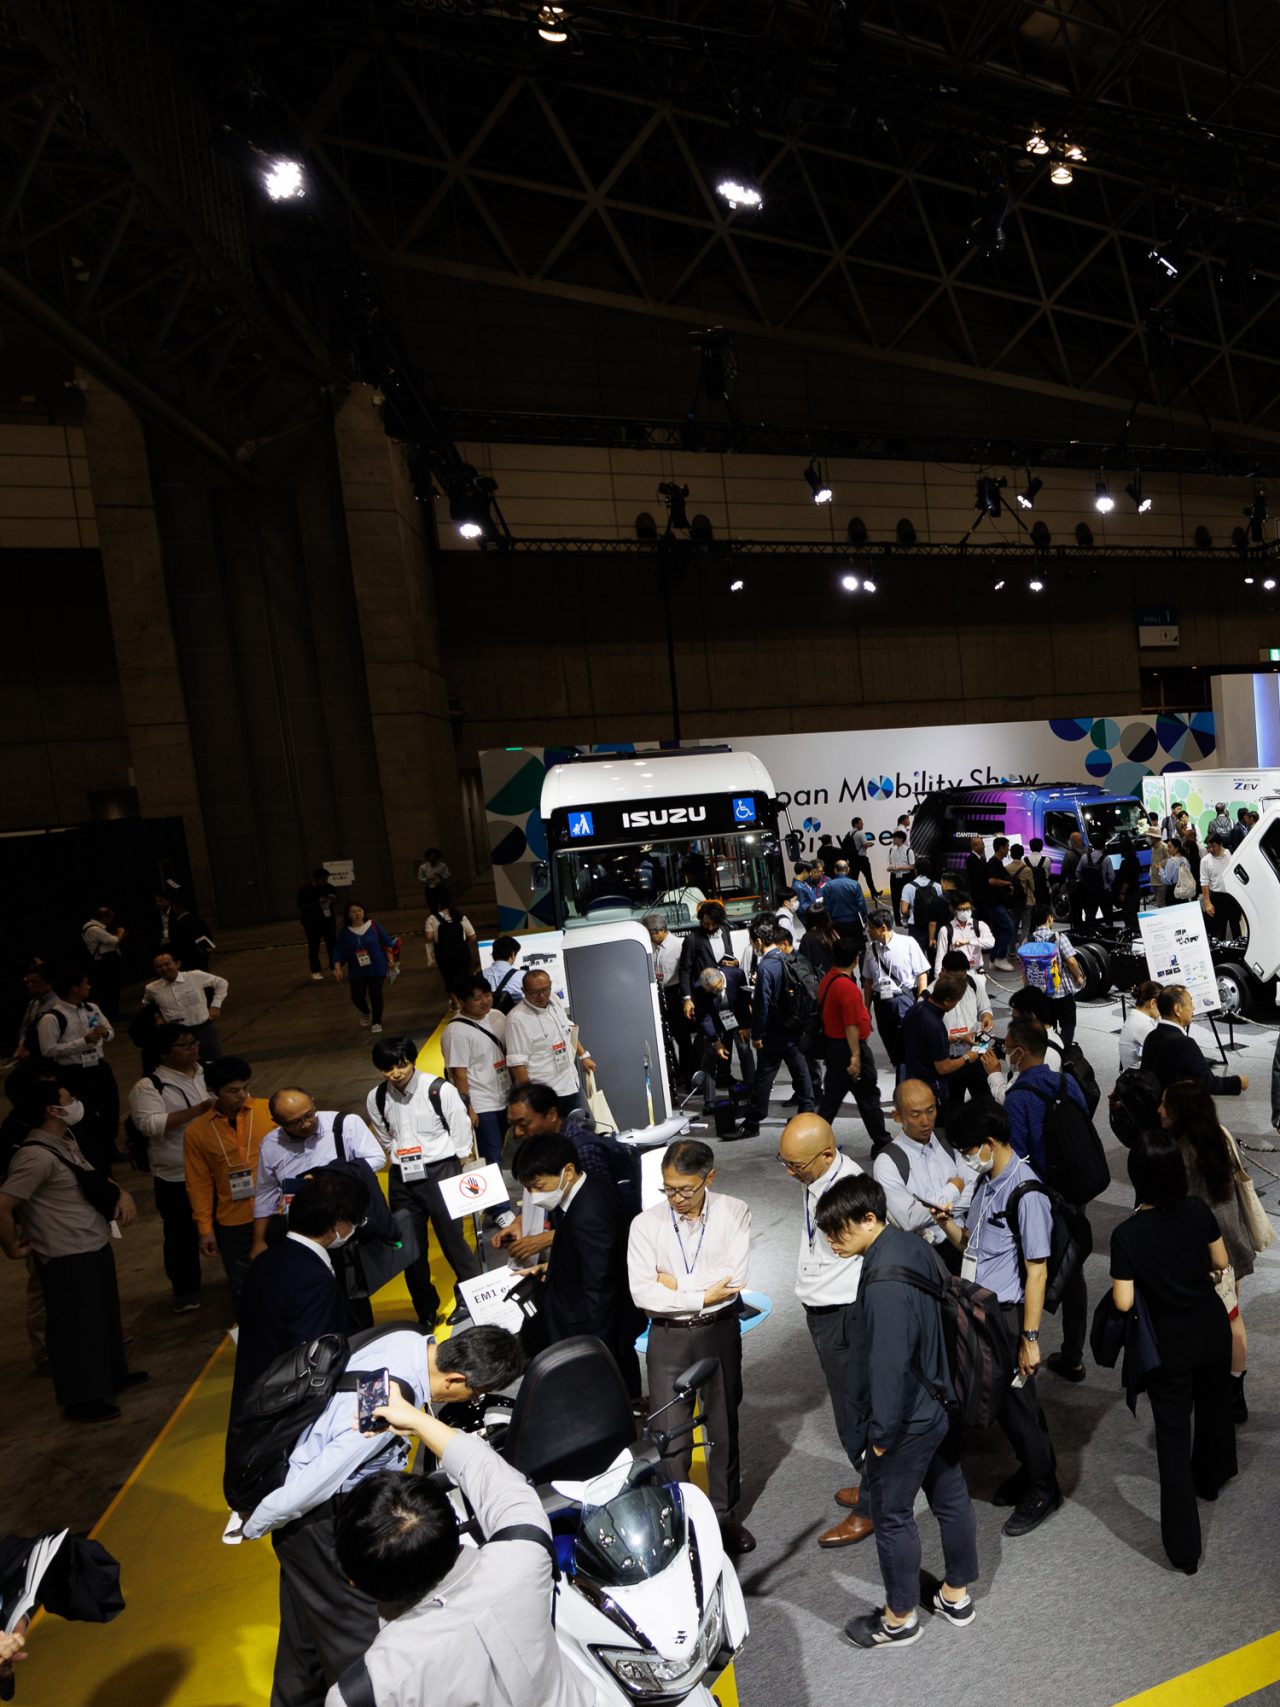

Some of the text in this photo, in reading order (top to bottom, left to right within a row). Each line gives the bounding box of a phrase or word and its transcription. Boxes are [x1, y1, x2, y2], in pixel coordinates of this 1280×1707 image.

[1234, 782, 1258, 791] ZEV
[775, 788, 828, 807] pan
[622, 806, 707, 828] ISUZU
[474, 1289, 498, 1304] EM1
